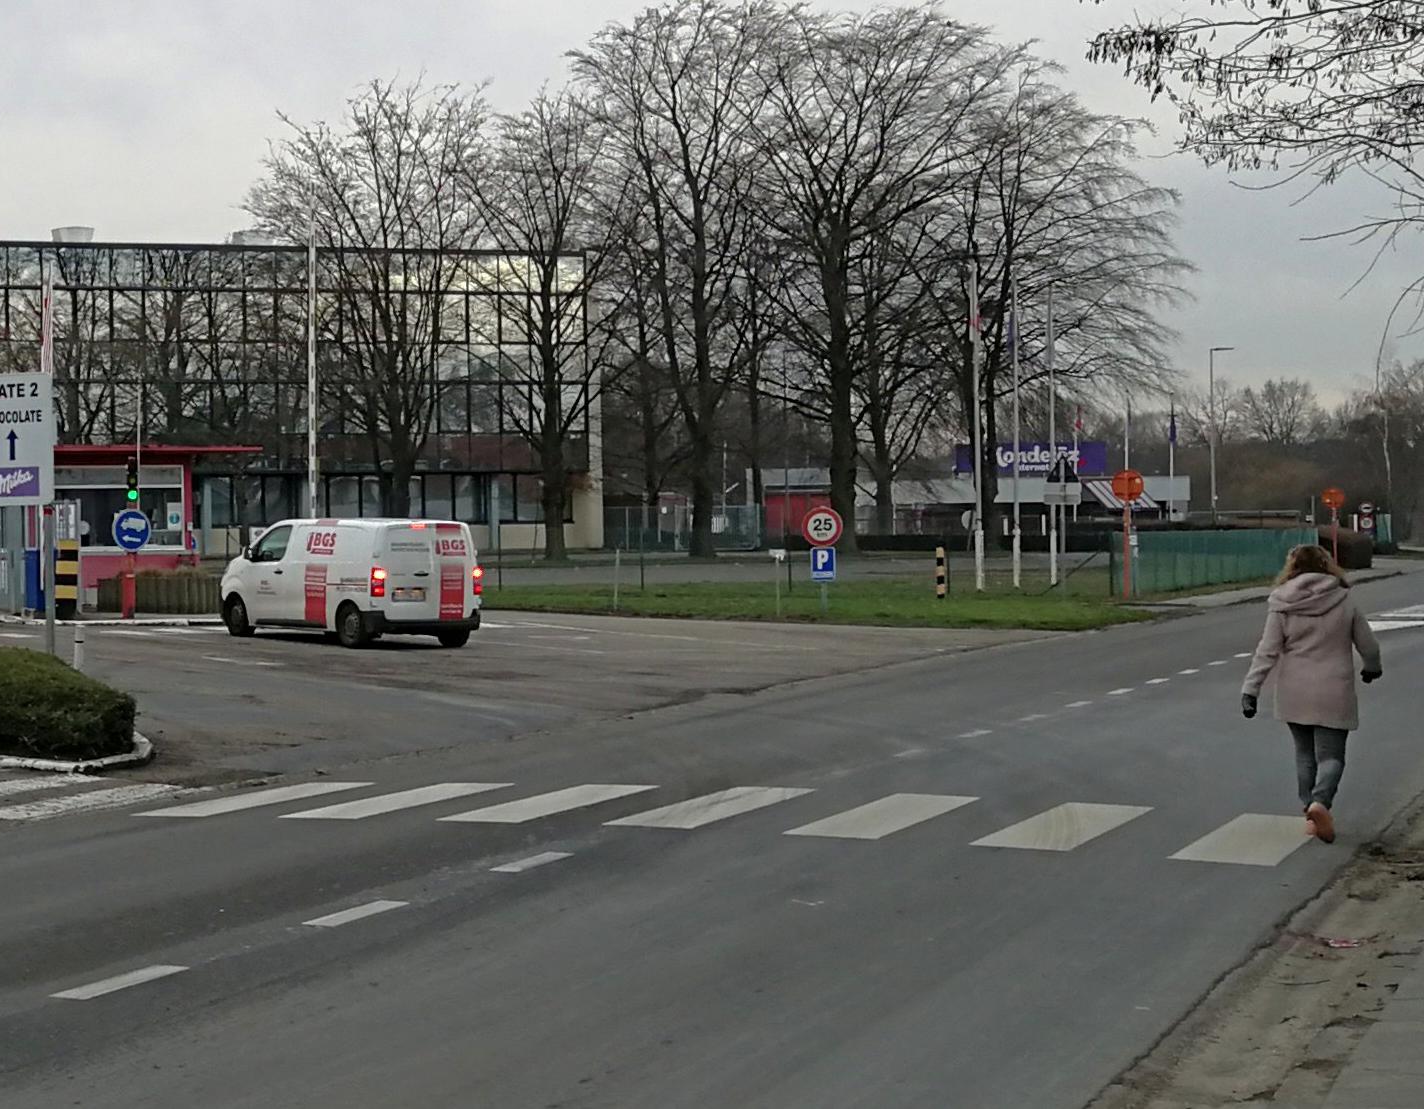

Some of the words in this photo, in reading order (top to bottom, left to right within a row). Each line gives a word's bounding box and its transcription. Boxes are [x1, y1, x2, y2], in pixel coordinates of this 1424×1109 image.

[30, 382, 39, 397] 2
[813, 518, 832, 531] 25
[313, 532, 337, 547] BGS
[441, 540, 465, 551] BGS
[817, 550, 829, 570] P
